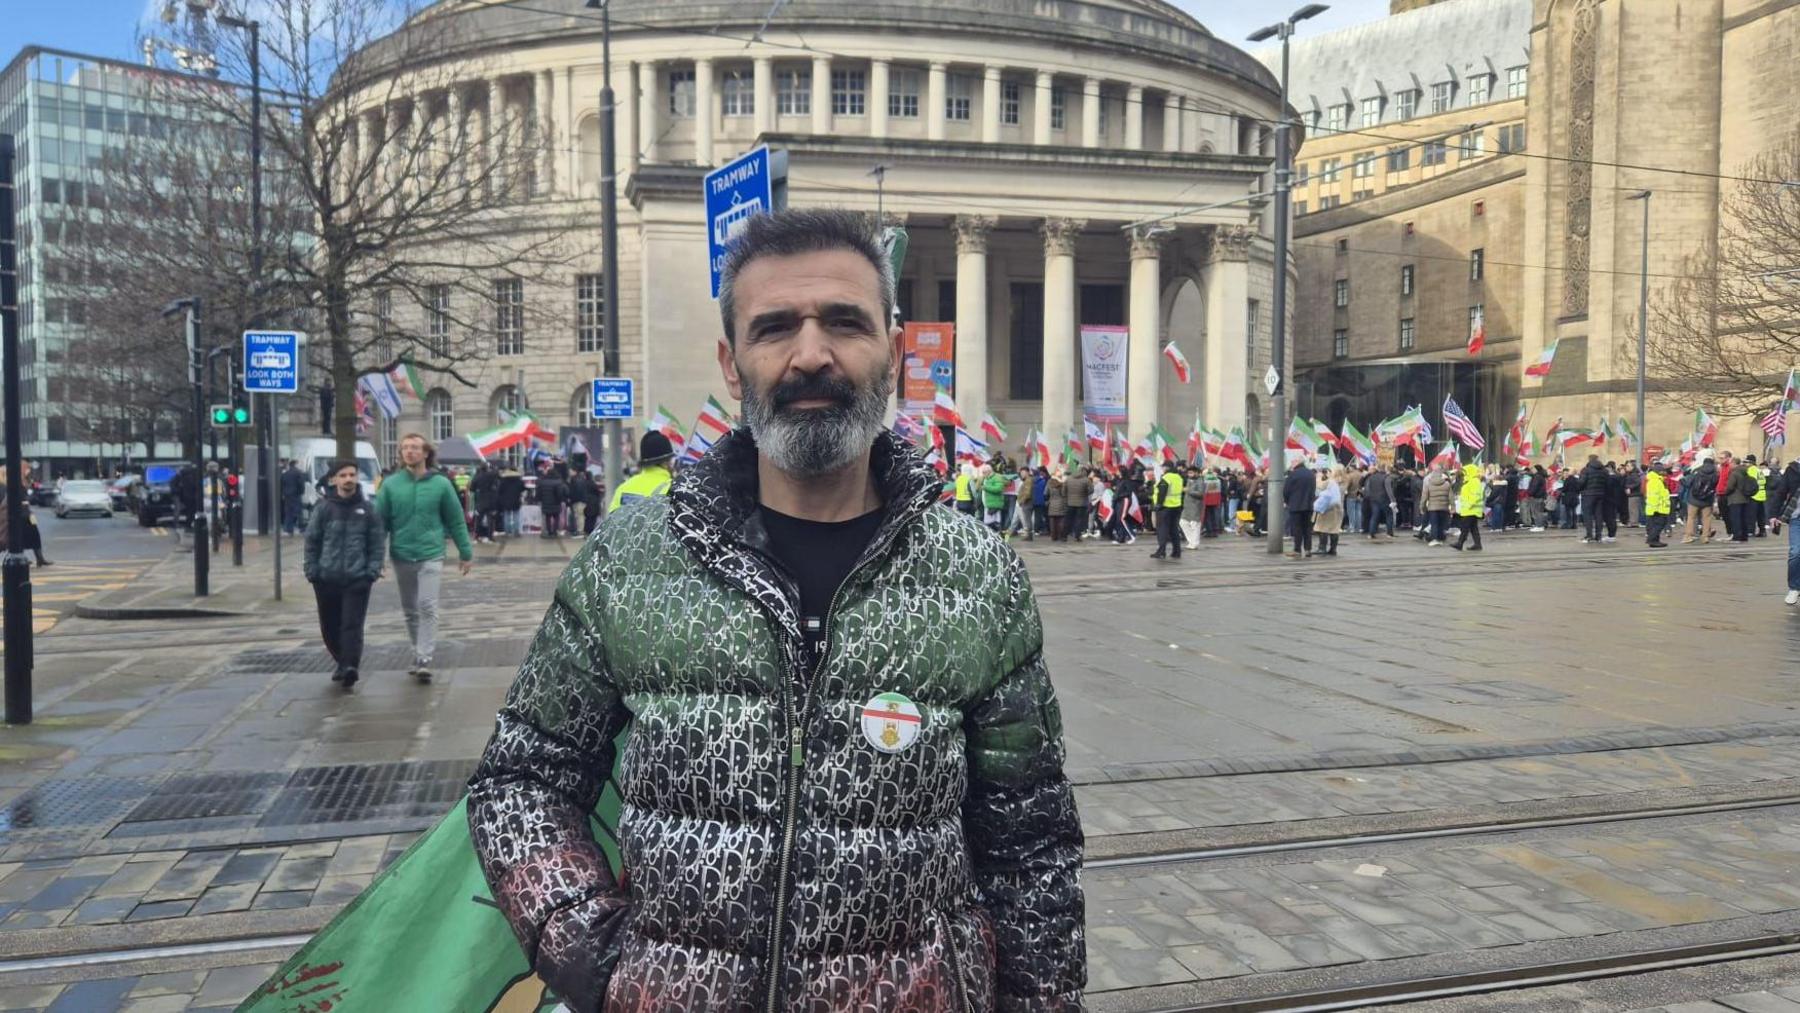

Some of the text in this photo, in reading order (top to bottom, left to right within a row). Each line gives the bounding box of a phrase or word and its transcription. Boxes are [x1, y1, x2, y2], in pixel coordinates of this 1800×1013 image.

[712, 158, 760, 195] TRAMWAY
[251, 335, 290, 344] TRAMWAY
[248, 370, 294, 379] LOOK BOTH
[259, 379, 282, 387] WAYS
